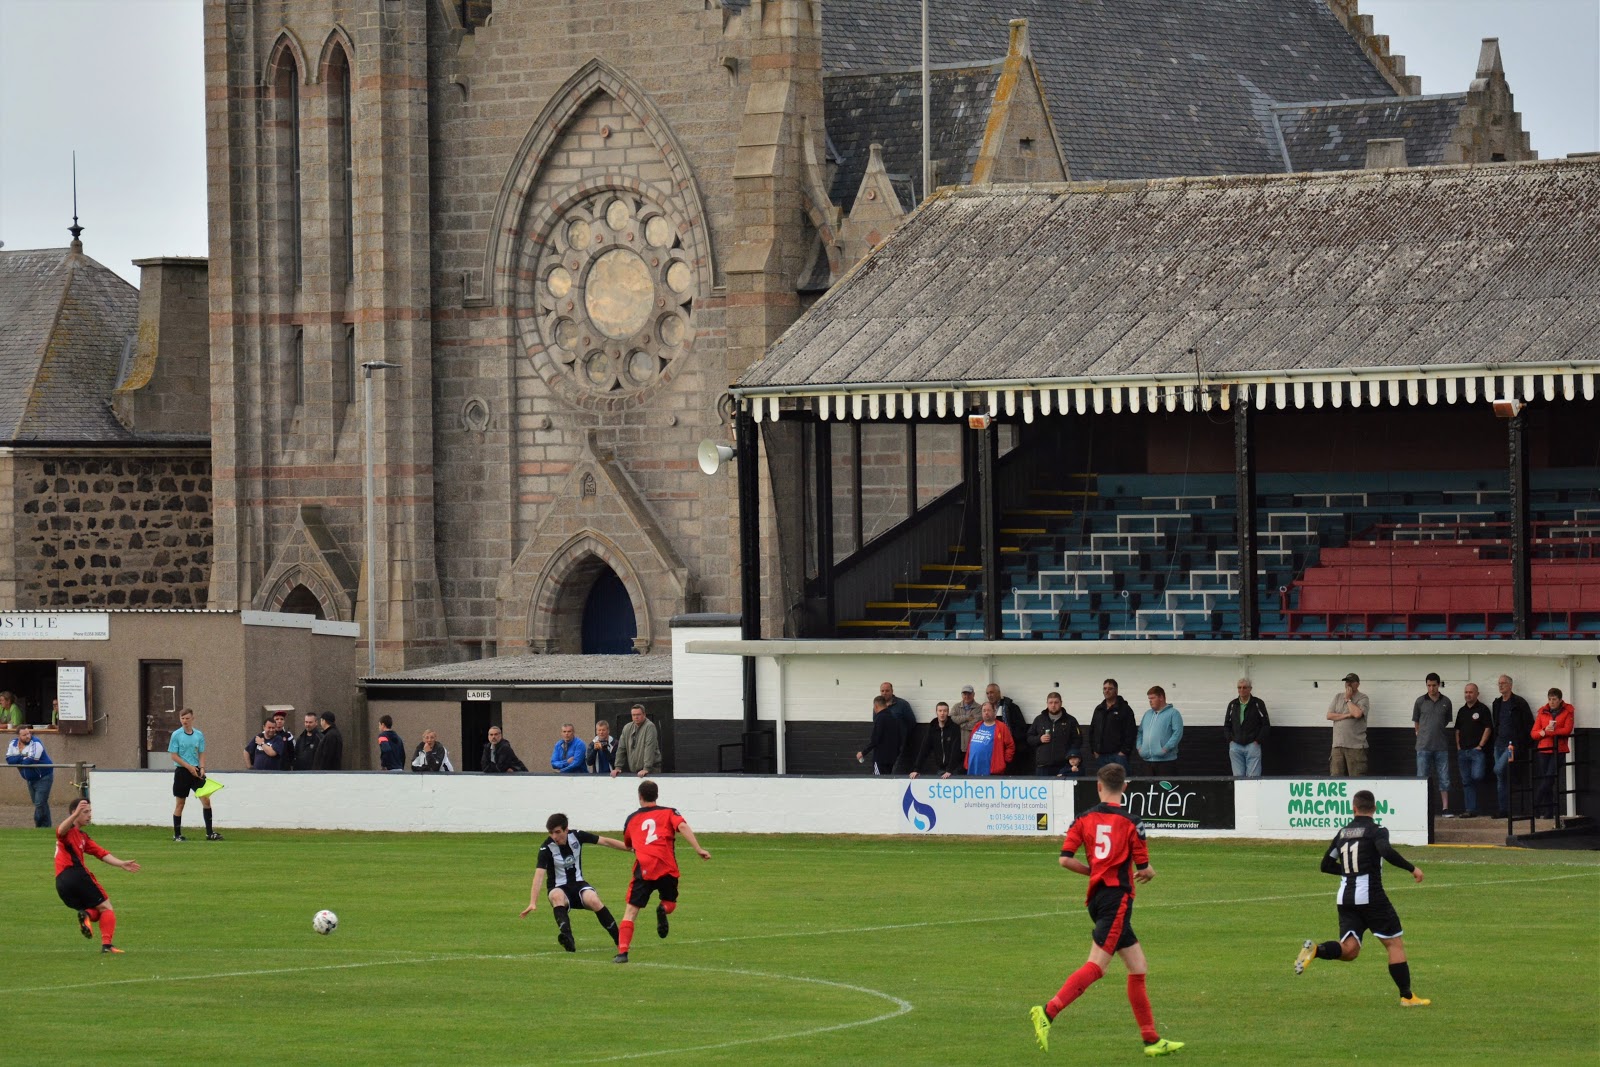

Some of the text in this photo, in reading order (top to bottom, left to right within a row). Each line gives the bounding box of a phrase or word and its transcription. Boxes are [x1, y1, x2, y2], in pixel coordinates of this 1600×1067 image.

[928, 780, 1048, 803] stephen bruce
[1289, 782, 1347, 797] WE ARE
[964, 802, 990, 810] plumbing
[1000, 802, 1021, 810] heating
[1287, 799, 1396, 816] MACMILN.
[641, 818, 659, 846] 2
[1289, 817, 1331, 828] CANCER
[1094, 824, 1112, 860] 5
[1340, 840, 1360, 874] 11
